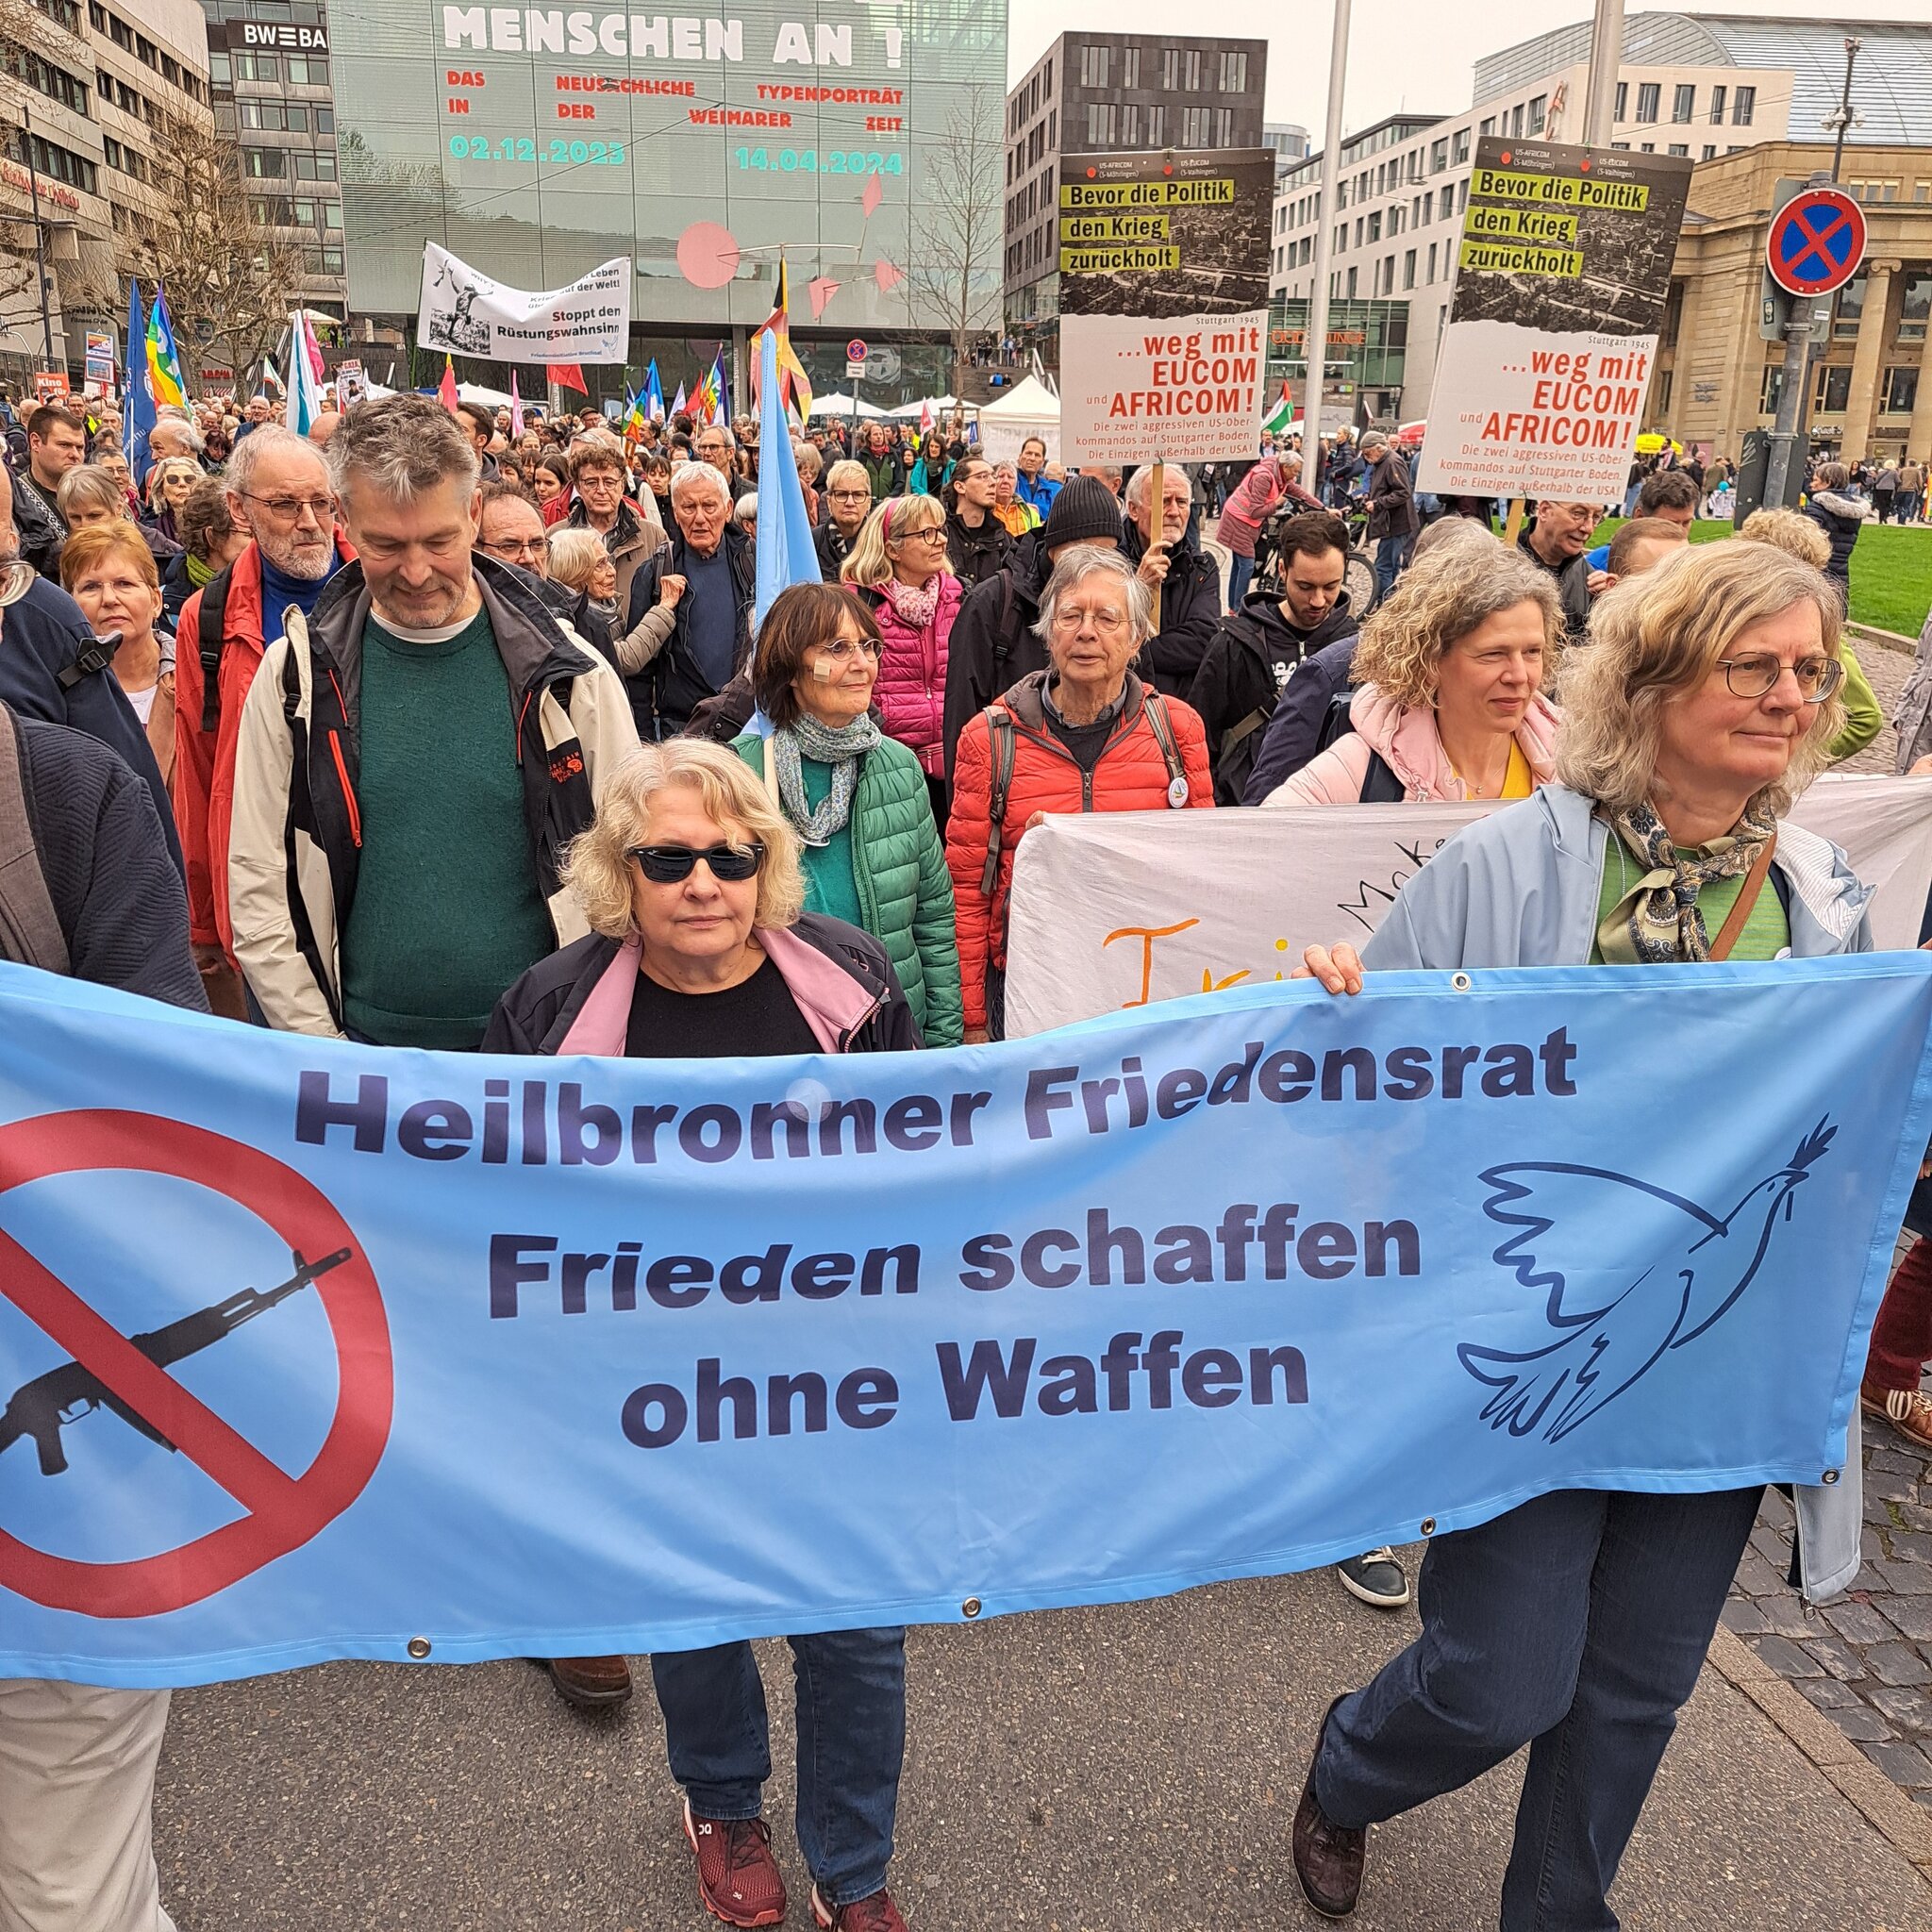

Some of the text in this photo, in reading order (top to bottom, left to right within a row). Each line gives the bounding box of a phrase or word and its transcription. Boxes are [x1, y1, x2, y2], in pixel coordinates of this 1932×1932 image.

[443, 5, 903, 68] MENSCHEN AN !
[447, 70, 486, 88] DAS
[757, 83, 904, 105] TYPENPORTRÄT
[448, 98, 904, 133] IN DER WEIMARER ZEIT
[449, 135, 903, 175] 02.12.2023 14.04.2024
[1071, 181, 1229, 205] Bevor die Politik
[1479, 172, 1643, 208] Bevor die Politik
[1070, 217, 1163, 239] den Krieg
[1474, 208, 1573, 242] den Krieg
[1070, 248, 1173, 269] zurückholt
[1467, 247, 1575, 275] zurückholt
[577, 283, 594, 292] der
[552, 307, 621, 323] Stoppt den
[1195, 317, 1236, 326] Stuttgart
[497, 324, 620, 341] Rüstungswahnsinn
[1118, 327, 1260, 360] ...weg mit
[1588, 335, 1650, 350] Stuttgart 1945
[1153, 358, 1257, 387] EUCOM
[1503, 351, 1647, 383] ...weg mit
[38, 377, 62, 387] Kino
[54, 387, 67, 395] für
[1087, 395, 1108, 406] und
[1532, 381, 1640, 416] EUCOM
[1093, 418, 1254, 432] Die zwei aggressiven US-Ober-
[1460, 412, 1483, 424] und
[1075, 431, 1253, 445] kommandos auf Stuttgarter Boden.
[1089, 444, 1253, 461] Die Einzigen außerhalb der USA!
[1461, 444, 1626, 464] Die zwei aggressiven US-Ober-
[1441, 458, 1622, 480] kommandos auf Stuttgarter Boden.
[1450, 475, 1621, 497] Die Einzigen außerhalb der USA!
[294, 1024, 1577, 1167] Heilbronner Friedensrat
[490, 1203, 1422, 1320] Frieden schaffen
[621, 1330, 1309, 1450] ohne Waffen
